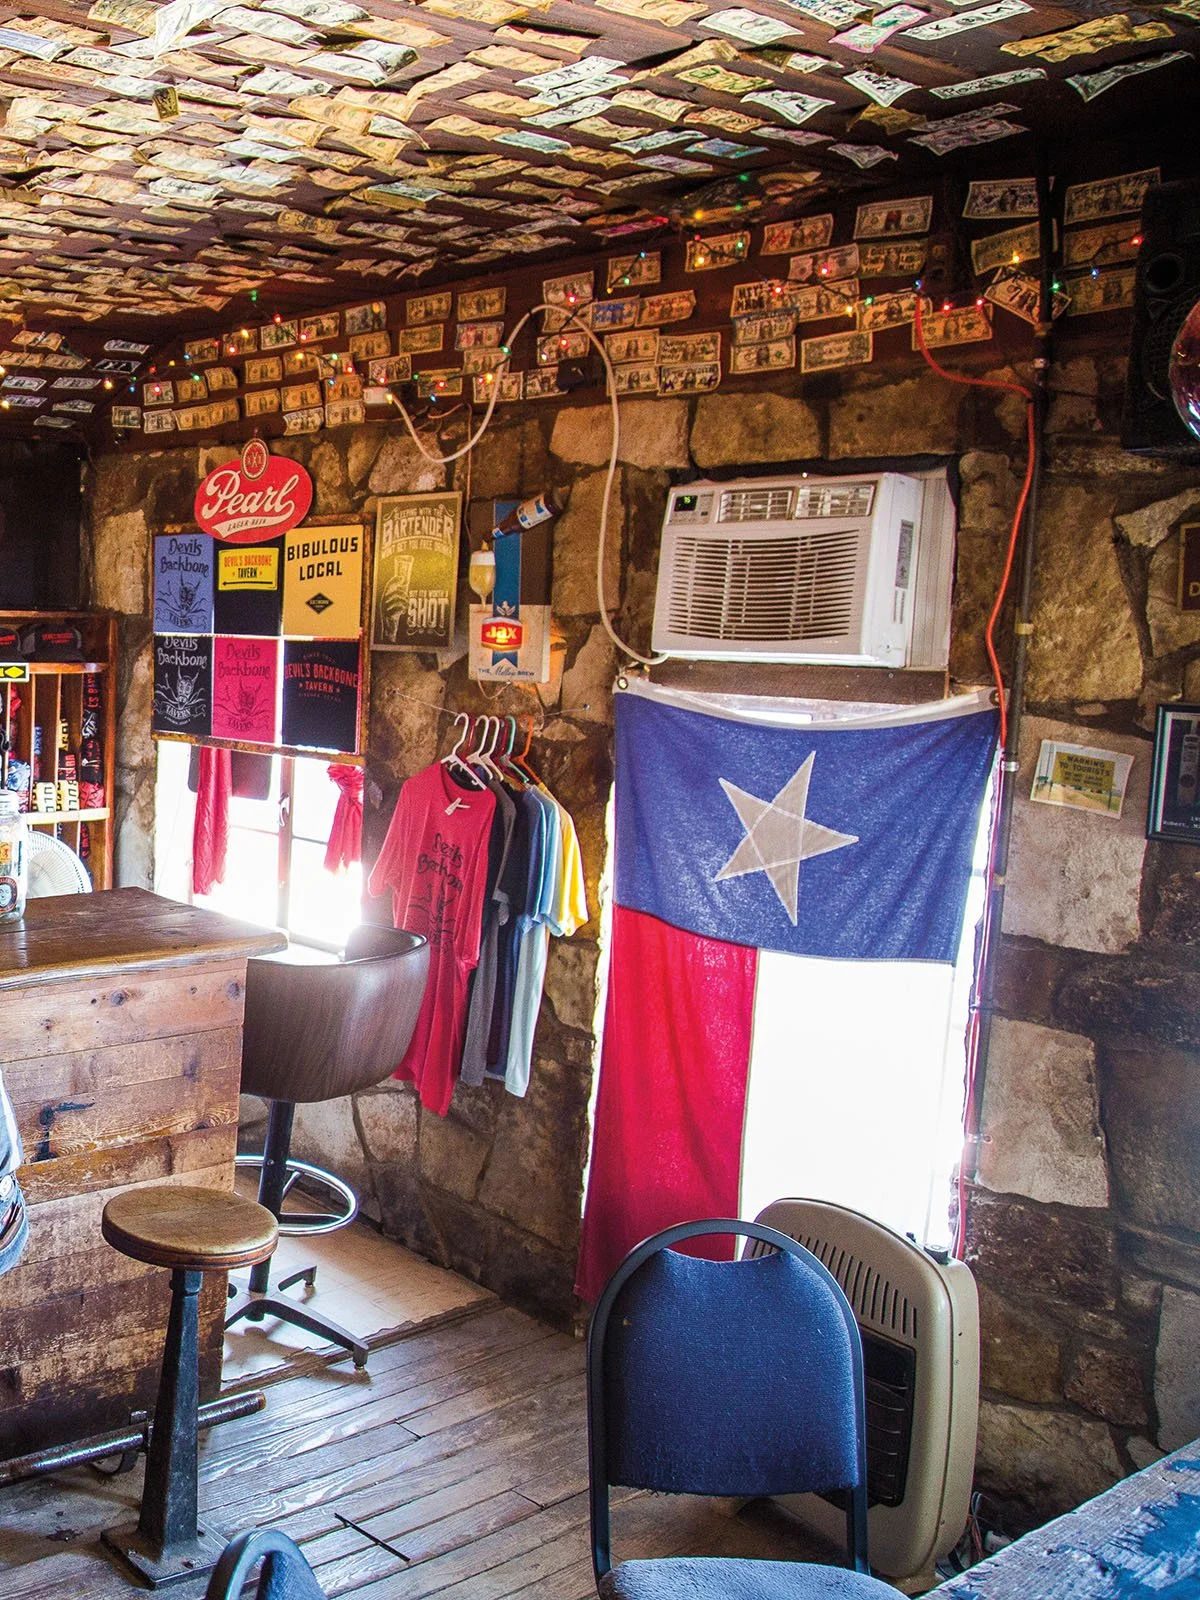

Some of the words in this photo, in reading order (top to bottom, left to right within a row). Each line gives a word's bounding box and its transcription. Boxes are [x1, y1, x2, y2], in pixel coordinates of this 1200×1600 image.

[201, 469, 300, 523] Pearl
[383, 515, 454, 547] BARTENDER
[168, 538, 202, 555] Devils
[287, 537, 359, 561] BIBULOUS
[160, 554, 209, 577] Backbone
[224, 555, 243, 567] DEVIL'S
[244, 554, 273, 566] BACKBONE
[238, 567, 258, 578] TAVERN
[300, 561, 343, 581] LOCAL
[408, 598, 449, 628] SHOT
[163, 635, 198, 651] Devils
[226, 643, 261, 660] Devils
[157, 648, 208, 669] Backbone
[218, 661, 270, 679] Backbone
[313, 664, 358, 688] BACKBONE
[305, 681, 334, 693] TAVERN
[166, 705, 191, 718] TAVERN
[1067, 756, 1104, 767] WARNING
[1073, 764, 1110, 776] TOURISTS
